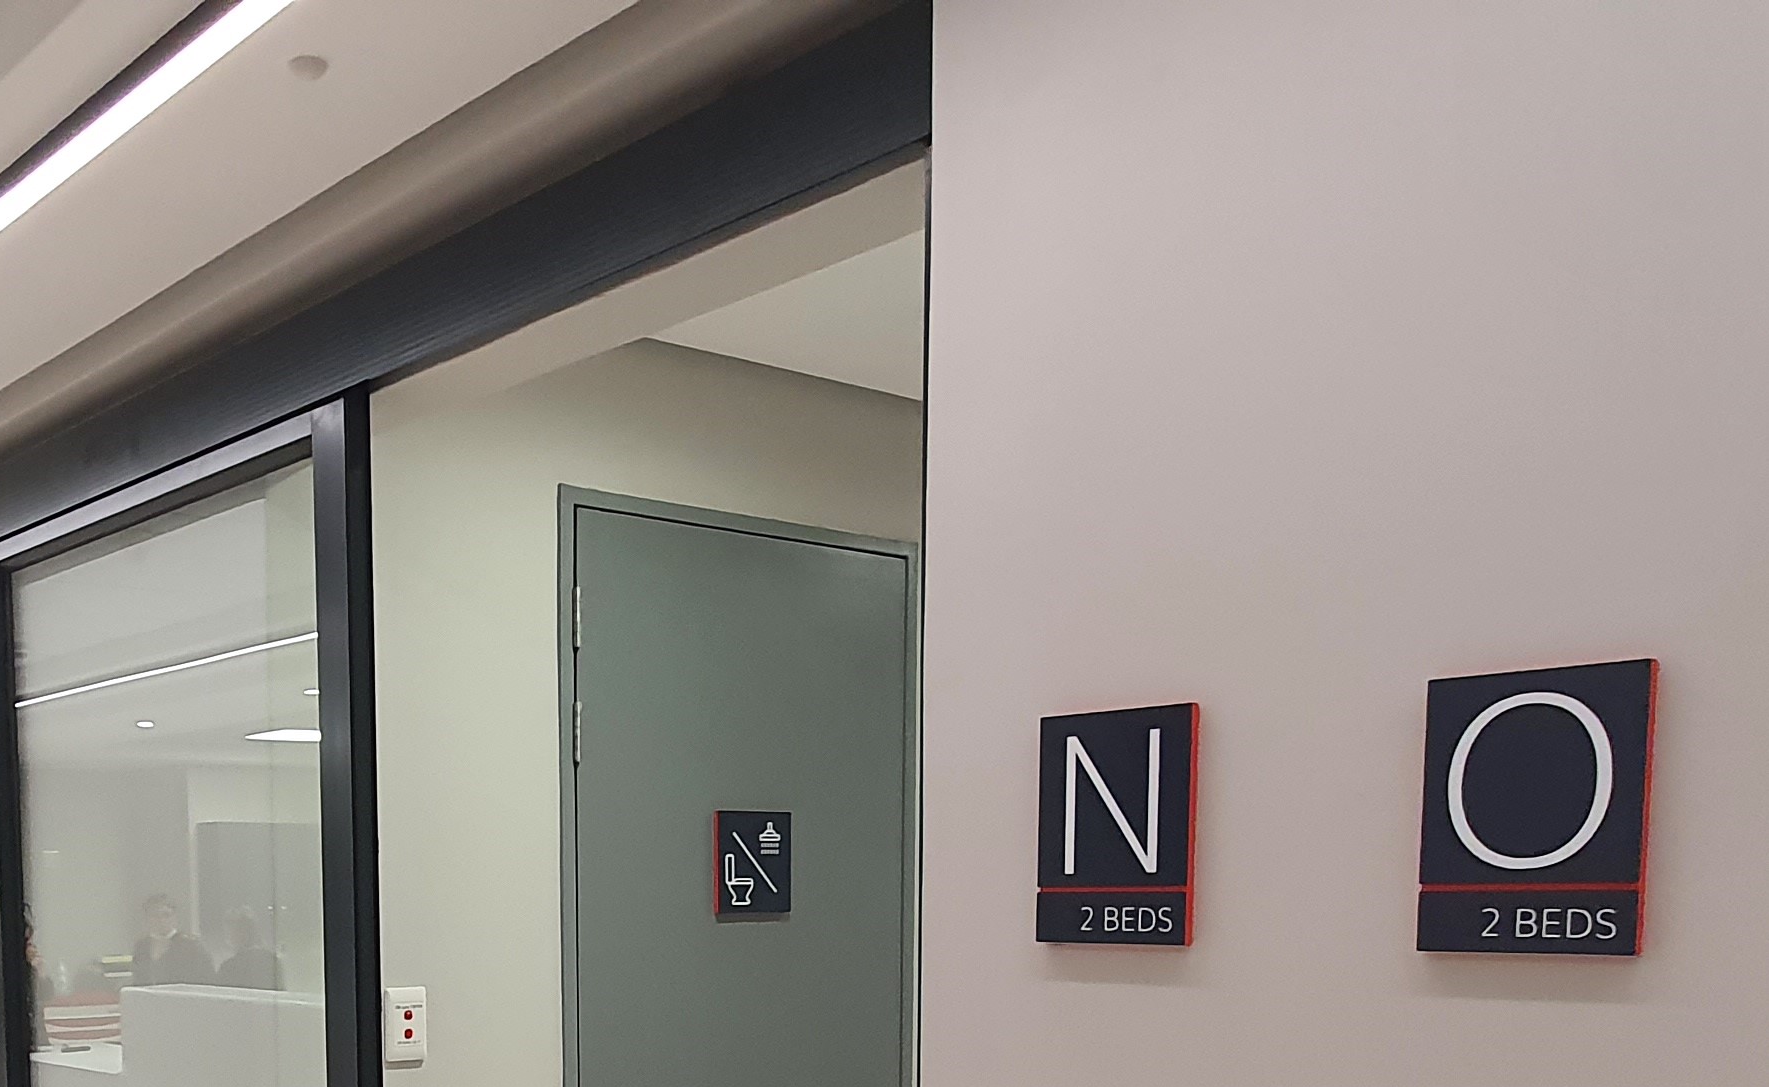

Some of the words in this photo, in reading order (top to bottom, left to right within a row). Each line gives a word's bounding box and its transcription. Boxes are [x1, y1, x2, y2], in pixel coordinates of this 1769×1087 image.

[1064, 727, 1161, 875] N
[1447, 691, 1613, 870] O
[1079, 906, 1094, 931] 2
[1103, 906, 1173, 932] BEDS
[1480, 907, 1500, 938] 2
[1515, 907, 1617, 939] BEDS
